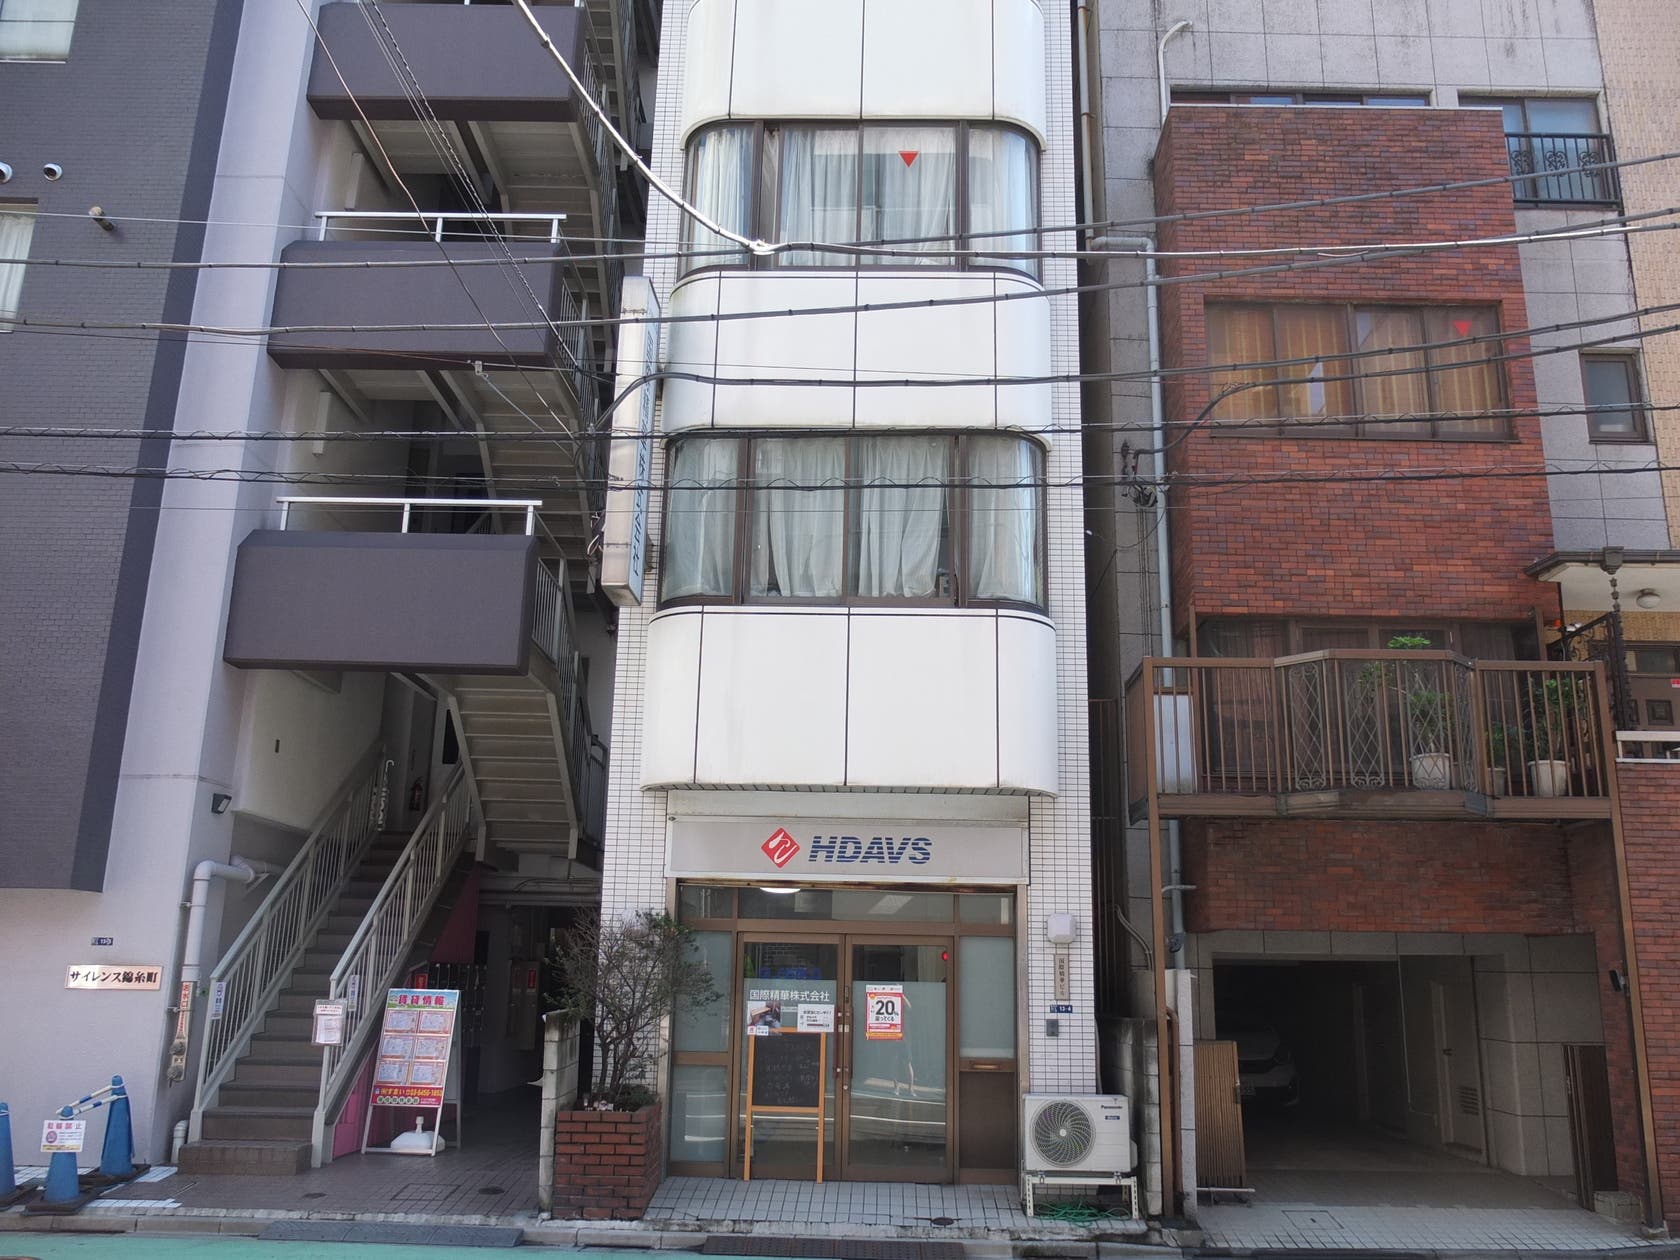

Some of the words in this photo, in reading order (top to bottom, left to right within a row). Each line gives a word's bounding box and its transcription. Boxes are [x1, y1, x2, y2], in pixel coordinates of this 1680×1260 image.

[808, 836, 933, 865] HDAVS
[70, 971, 158, 984] サイレンス錦糸町
[398, 994, 444, 1006] 賃貸情報
[750, 989, 830, 1002] 国際精華株式会社
